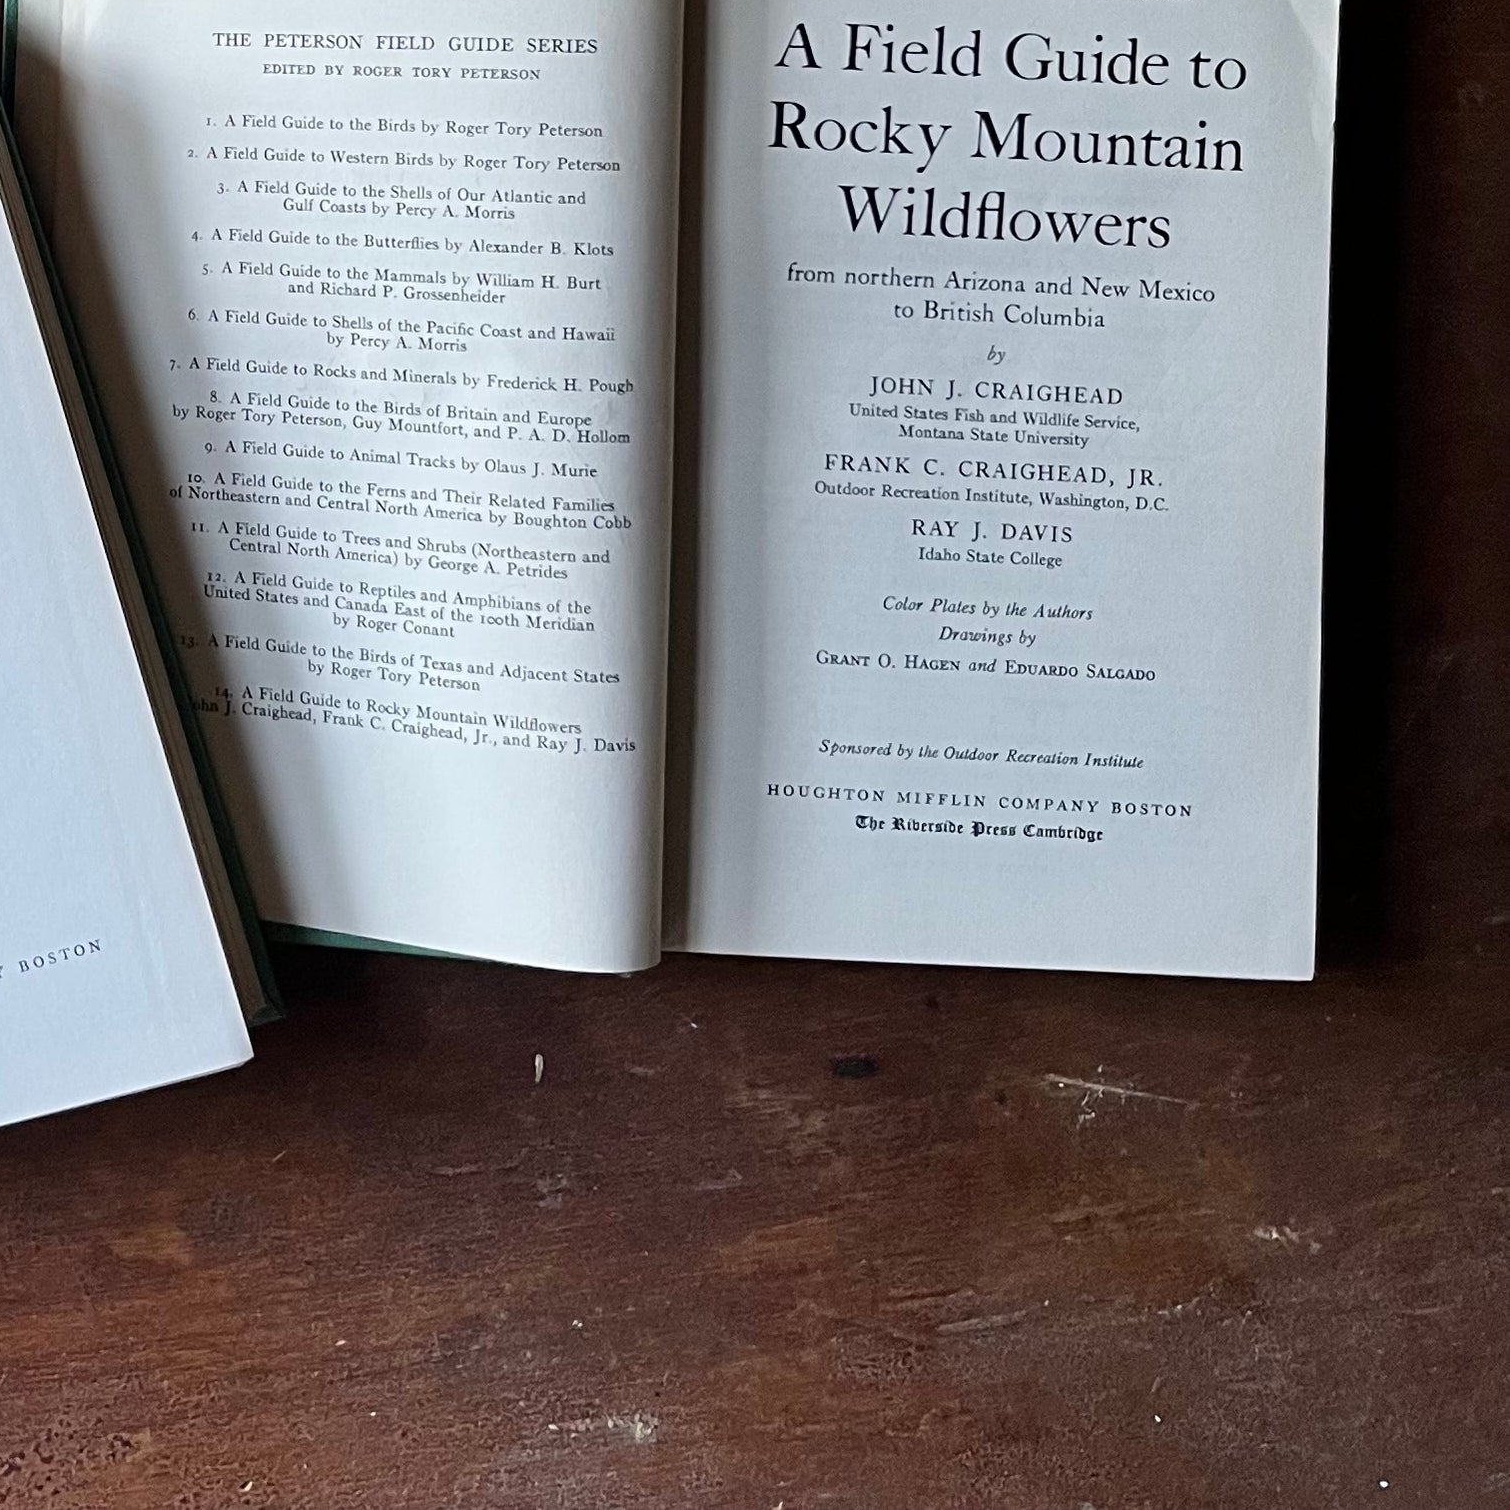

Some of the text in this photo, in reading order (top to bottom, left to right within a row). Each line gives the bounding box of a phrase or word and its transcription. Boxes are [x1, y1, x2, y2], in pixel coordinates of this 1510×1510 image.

[211, 32, 598, 54] THE PETERSON FIELD GUIDE SERIES
[774, 22, 1247, 90] A Field Guide to
[767, 100, 1243, 174] Rocky Mountain
[839, 185, 1171, 248] Wildflowers
[211, 228, 223, 241] A
[228, 228, 263, 243] Field
[268, 229, 311, 245] Guide
[315, 233, 331, 246] to
[335, 233, 359, 248] the
[363, 234, 440, 251] Butterflies
[444, 237, 463, 255] by
[468, 238, 544, 255] Alexander
[573, 241, 614, 257] Klots
[326, 331, 345, 348] by
[350, 332, 391, 351] Percy
[417, 336, 468, 353] Morris
[869, 376, 1123, 405] JOHN J. CRAIGHEAD
[849, 402, 1140, 434] United States Fish and Wildlife Service,
[938, 625, 1037, 648] Drawings by
[855, 814, 1104, 843] The Riverside Press Cambridge
[18, 938, 101, 973] BOSTON
